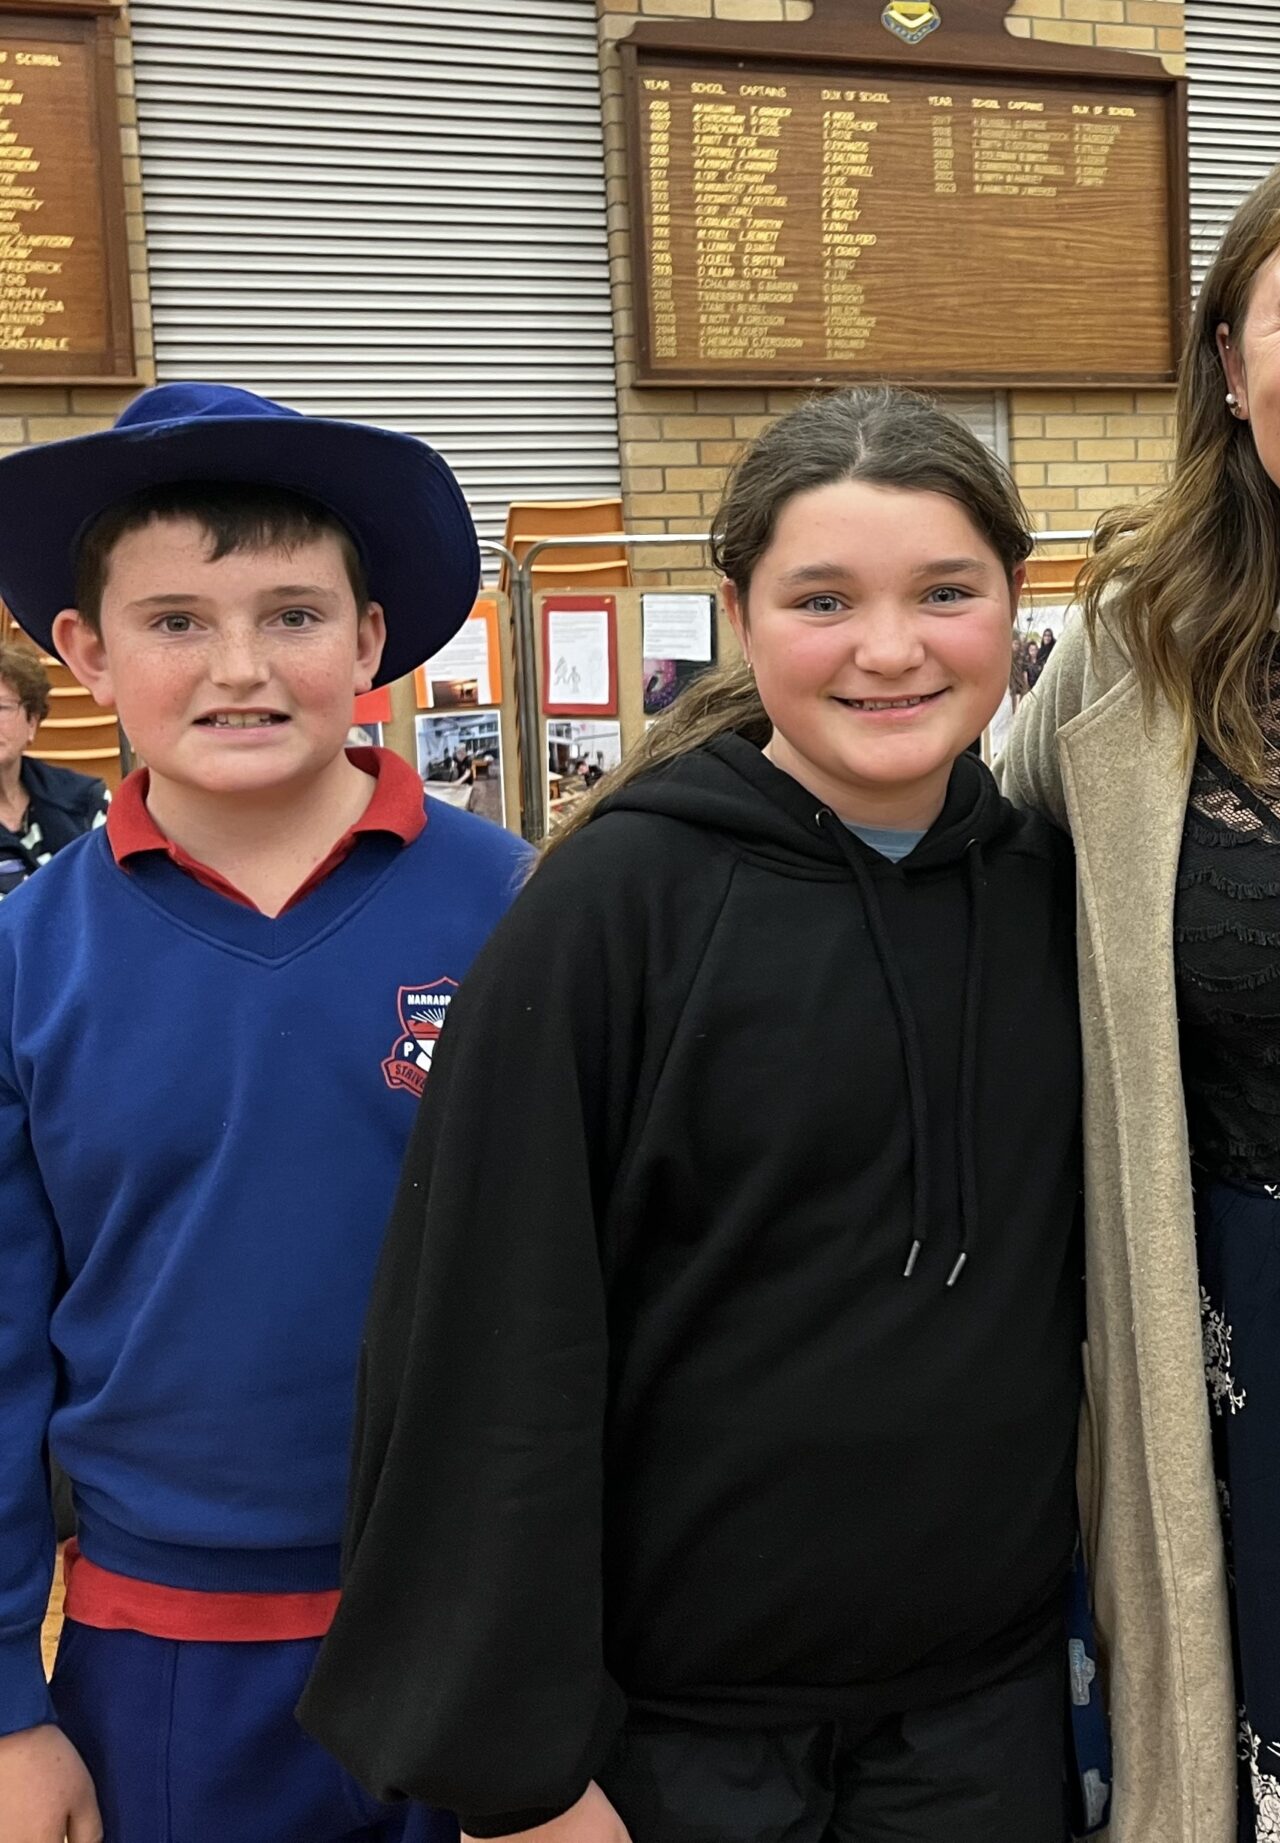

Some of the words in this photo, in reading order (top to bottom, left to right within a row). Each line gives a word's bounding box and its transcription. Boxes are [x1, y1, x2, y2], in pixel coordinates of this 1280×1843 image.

[643, 80, 671, 91] YEAR
[691, 82, 727, 95] SCHOOL
[739, 85, 787, 98] CAPTAINS
[928, 96, 953, 107] YEAR
[404, 1041, 414, 1057] P
